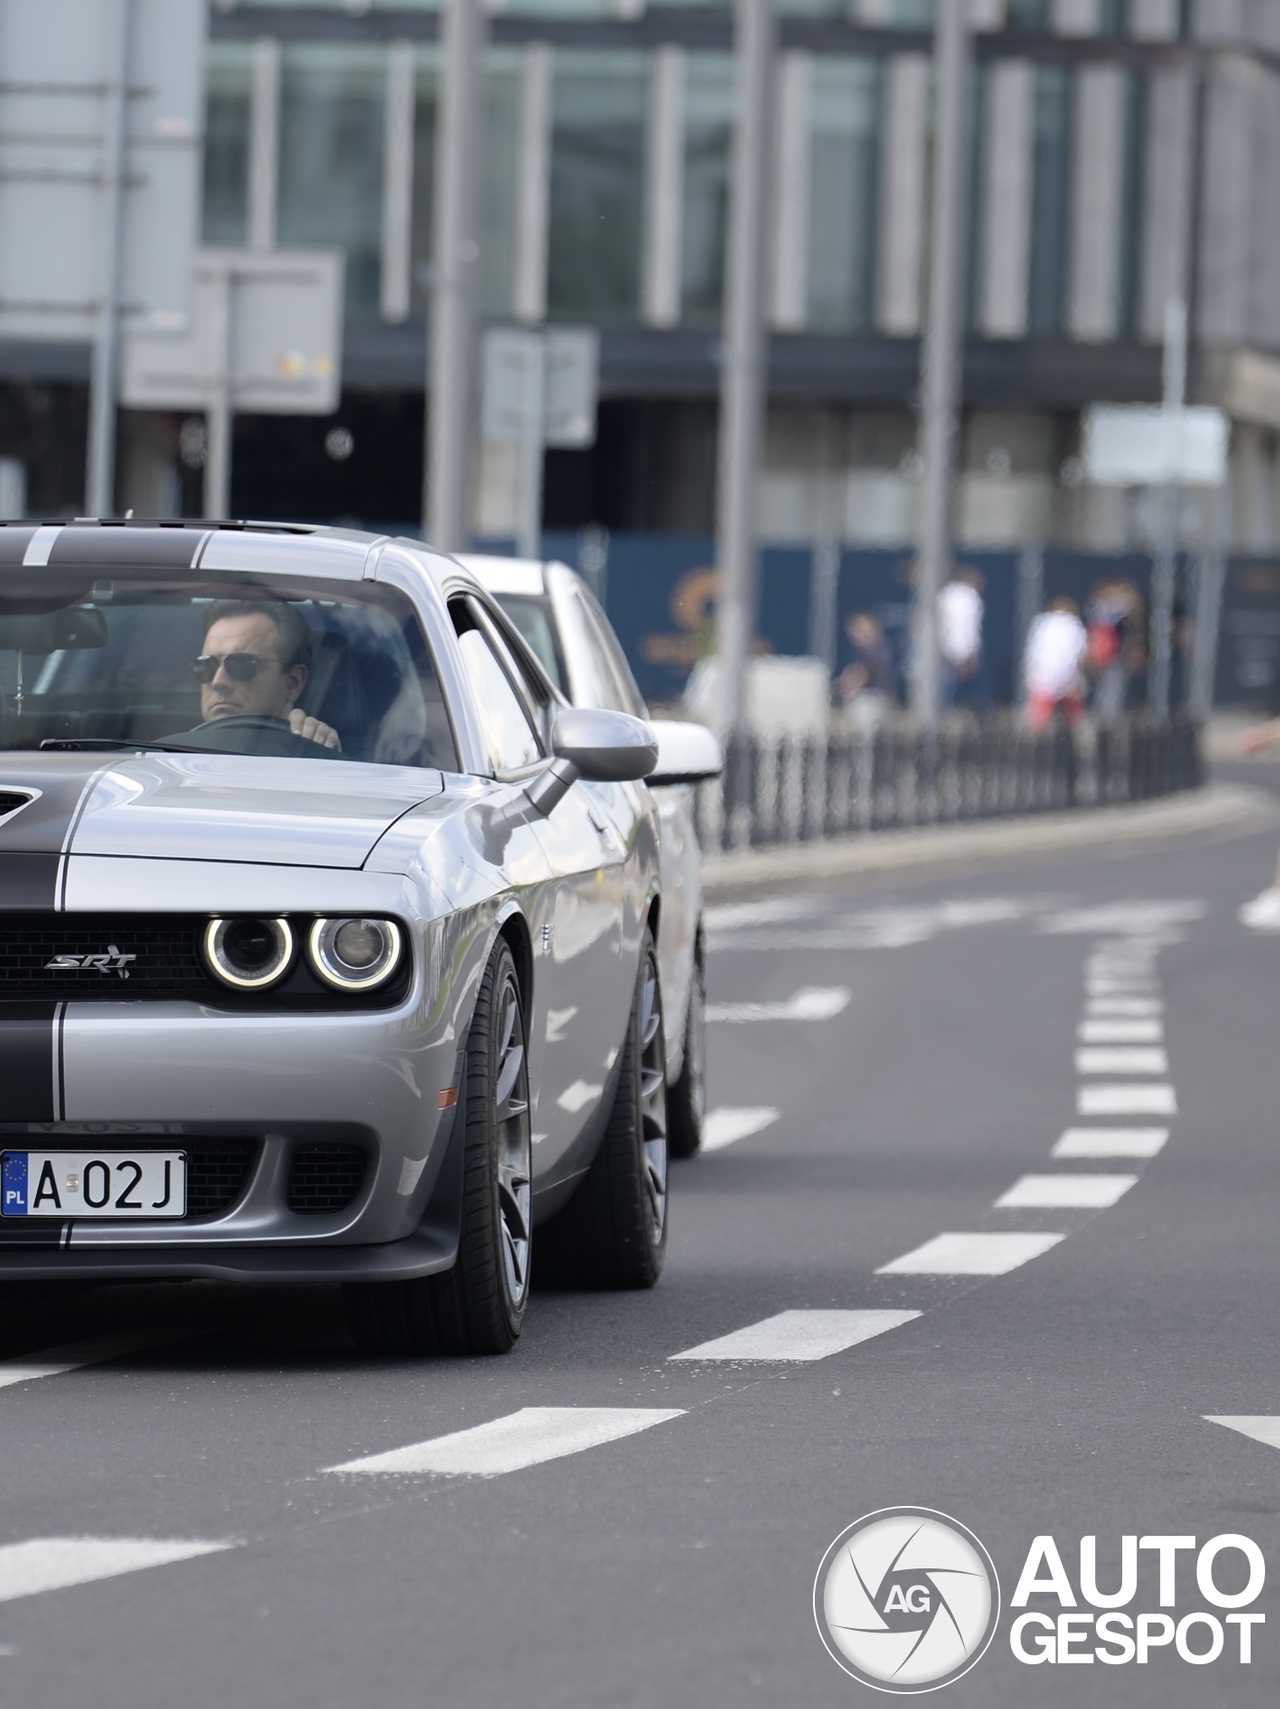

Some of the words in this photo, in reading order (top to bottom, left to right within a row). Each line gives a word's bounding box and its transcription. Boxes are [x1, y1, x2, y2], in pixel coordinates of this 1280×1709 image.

[44, 953, 137, 974] SRT
[33, 1160, 62, 1209] A
[83, 1160, 172, 1209] 02J
[6, 1191, 25, 1205] PL
